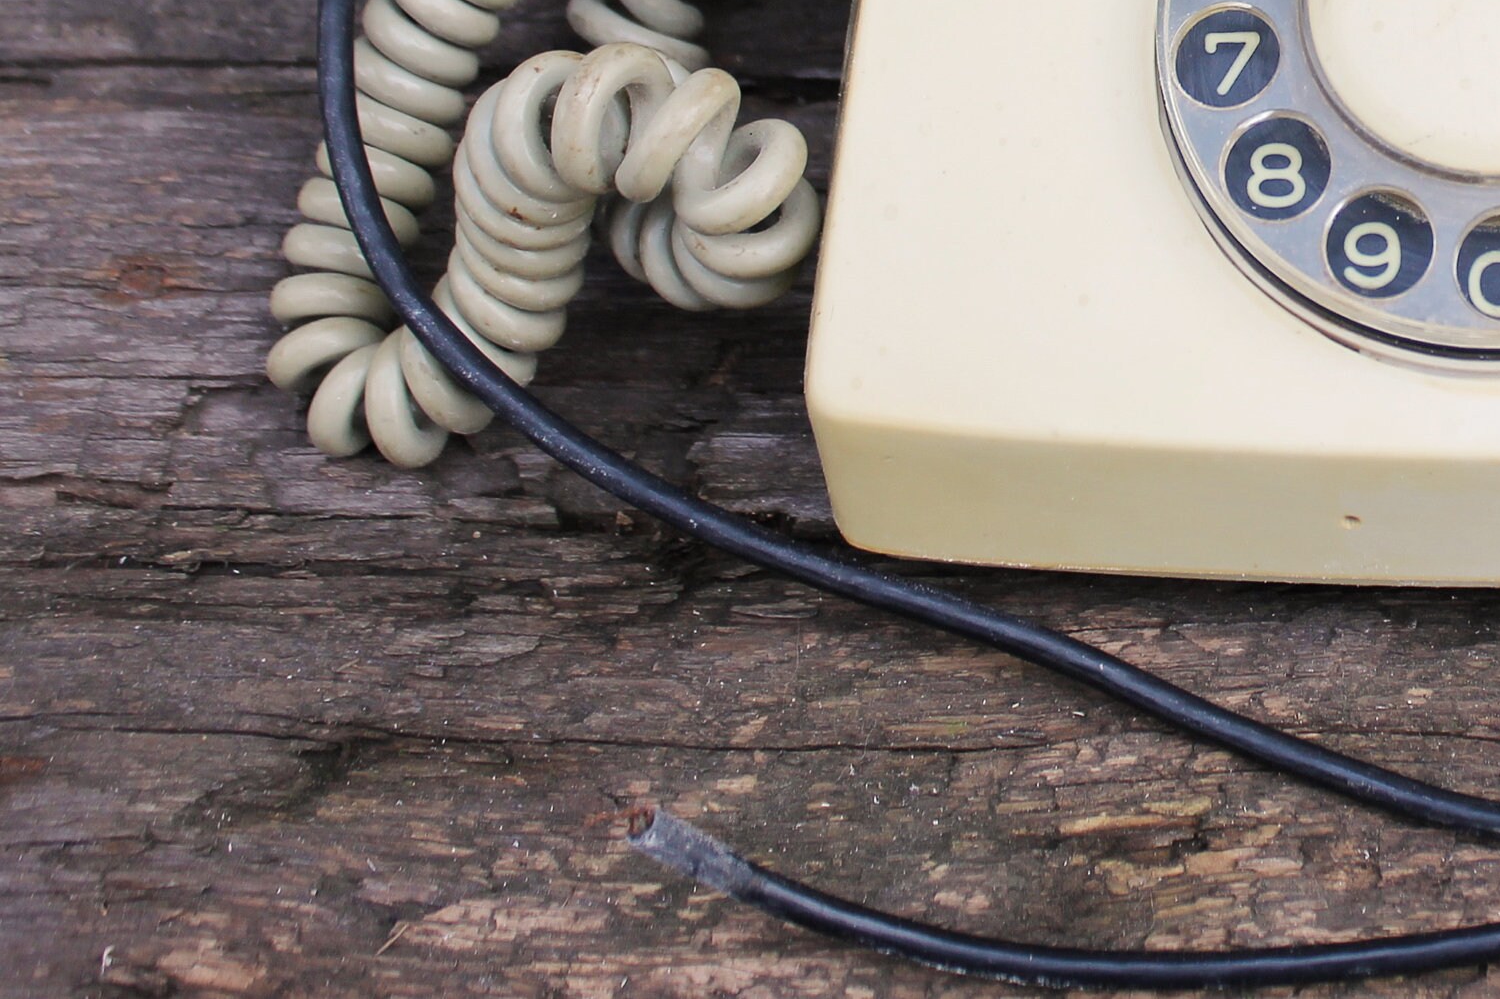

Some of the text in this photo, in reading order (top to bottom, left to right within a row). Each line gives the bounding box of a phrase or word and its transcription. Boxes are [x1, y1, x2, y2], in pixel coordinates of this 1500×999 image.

[1205, 31, 1261, 96] 7
[1246, 142, 1306, 208] 8
[1343, 222, 1401, 290] 9
